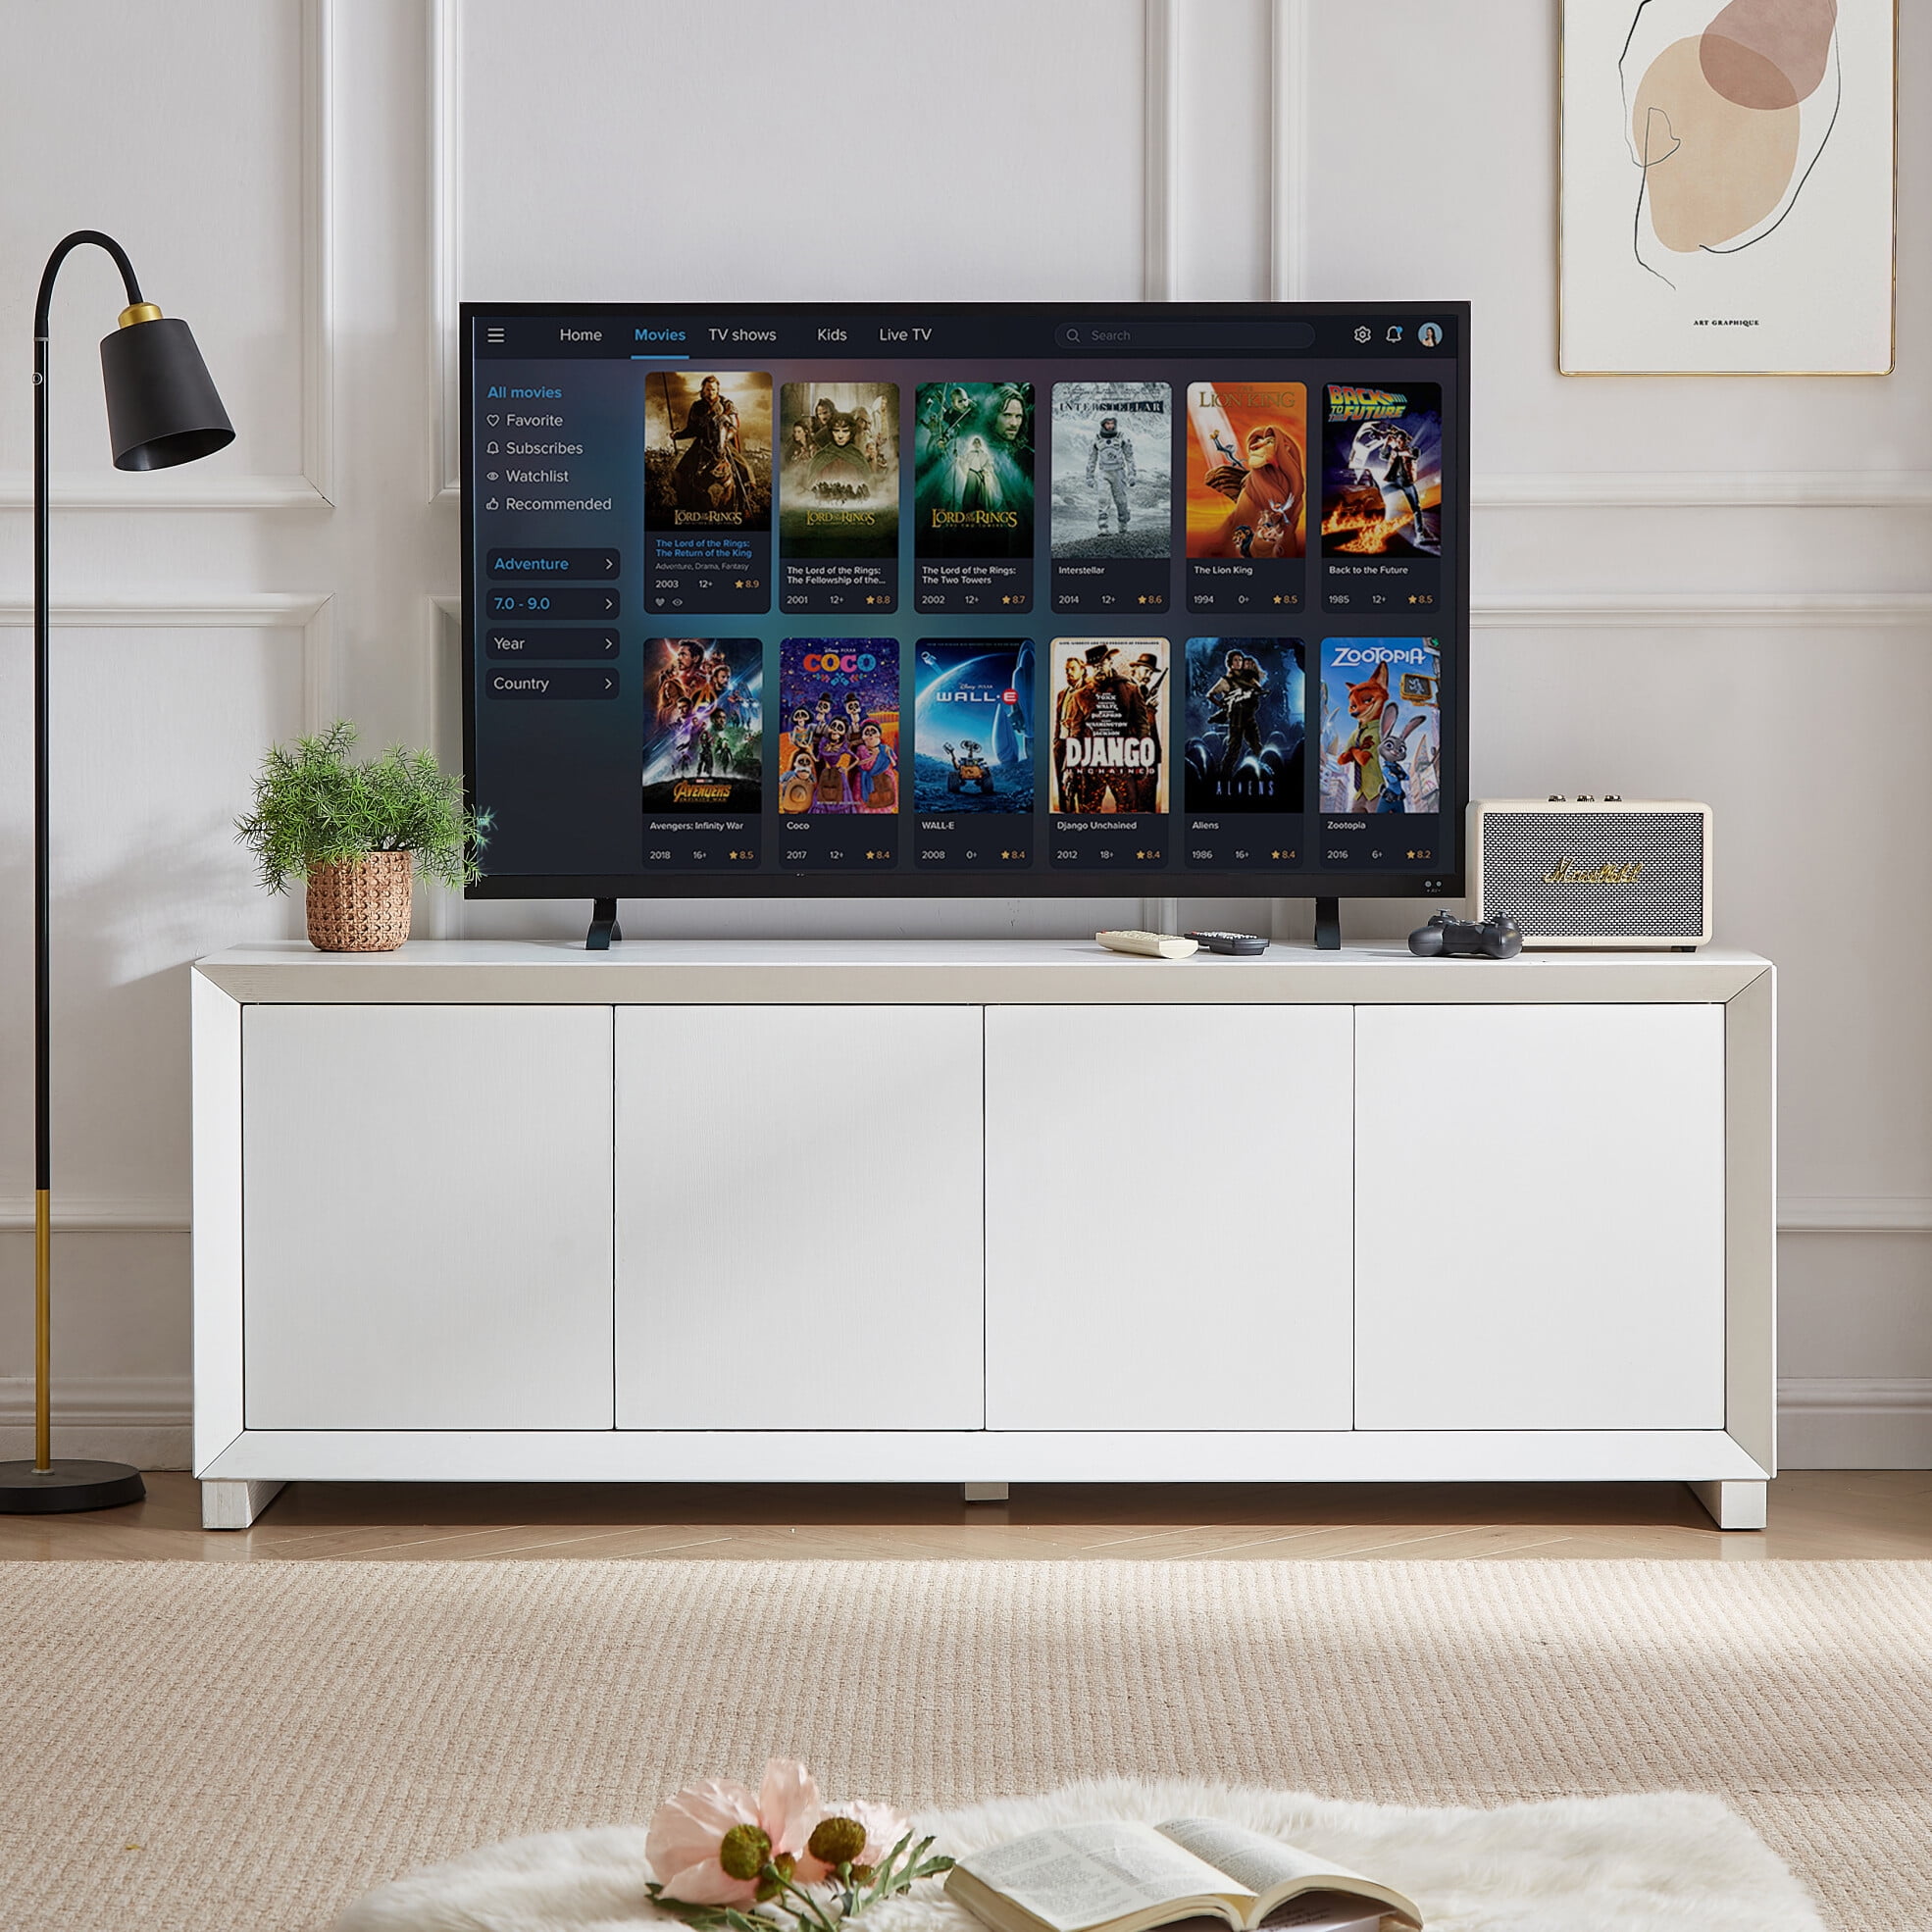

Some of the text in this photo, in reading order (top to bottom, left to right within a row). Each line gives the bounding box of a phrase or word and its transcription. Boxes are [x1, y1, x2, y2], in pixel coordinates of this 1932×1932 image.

[561, 329, 602, 341] Home
[636, 329, 686, 340] Movies
[709, 329, 776, 341] TV shows
[818, 329, 847, 341] Kids
[880, 329, 932, 340] Live TV
[1091, 330, 1131, 342] Search
[487, 386, 562, 398] All movies
[1327, 384, 1396, 405] BACK
[1198, 392, 1295, 408] LION KING
[1344, 406, 1406, 420] FUTURE
[507, 414, 563, 427] Favorite
[507, 442, 583, 454] Subscribes
[506, 470, 569, 483] Watchlist
[507, 498, 611, 510] Recommended
[976, 510, 1018, 528] RINGS
[724, 539, 749, 549] Rings:
[733, 549, 752, 559] King
[494, 558, 569, 570] Adventure
[854, 567, 881, 577] Rings:
[990, 567, 1016, 576] Rings:
[1233, 567, 1252, 576] King
[805, 577, 852, 585] Fellowship
[494, 597, 514, 610] 7.0
[528, 597, 549, 609] 9.0
[787, 595, 890, 604] 2001 12+ 8.8
[922, 595, 1025, 604] 2002 12+ 8.7
[1059, 595, 1079, 604] 2014
[1102, 595, 1115, 604] 12+
[494, 637, 525, 649] Year
[803, 653, 877, 673] COCO
[1331, 647, 1426, 667] ZOOTOPIA
[494, 677, 549, 692] Country
[1066, 737, 1155, 767] DJANGO
[1216, 781, 1274, 795] ALIENS
[650, 822, 693, 832] Avengers:
[695, 822, 725, 831] Infinity
[1057, 822, 1089, 831] Django
[1328, 821, 1366, 831] Zootopia
[922, 850, 1025, 859] 2008 0+ 8.4
[1057, 850, 1160, 859] 2012 18+ 8.4
[1193, 850, 1213, 859] 1986
[1236, 850, 1248, 859] 16+
[1372, 850, 1382, 859] 6+
